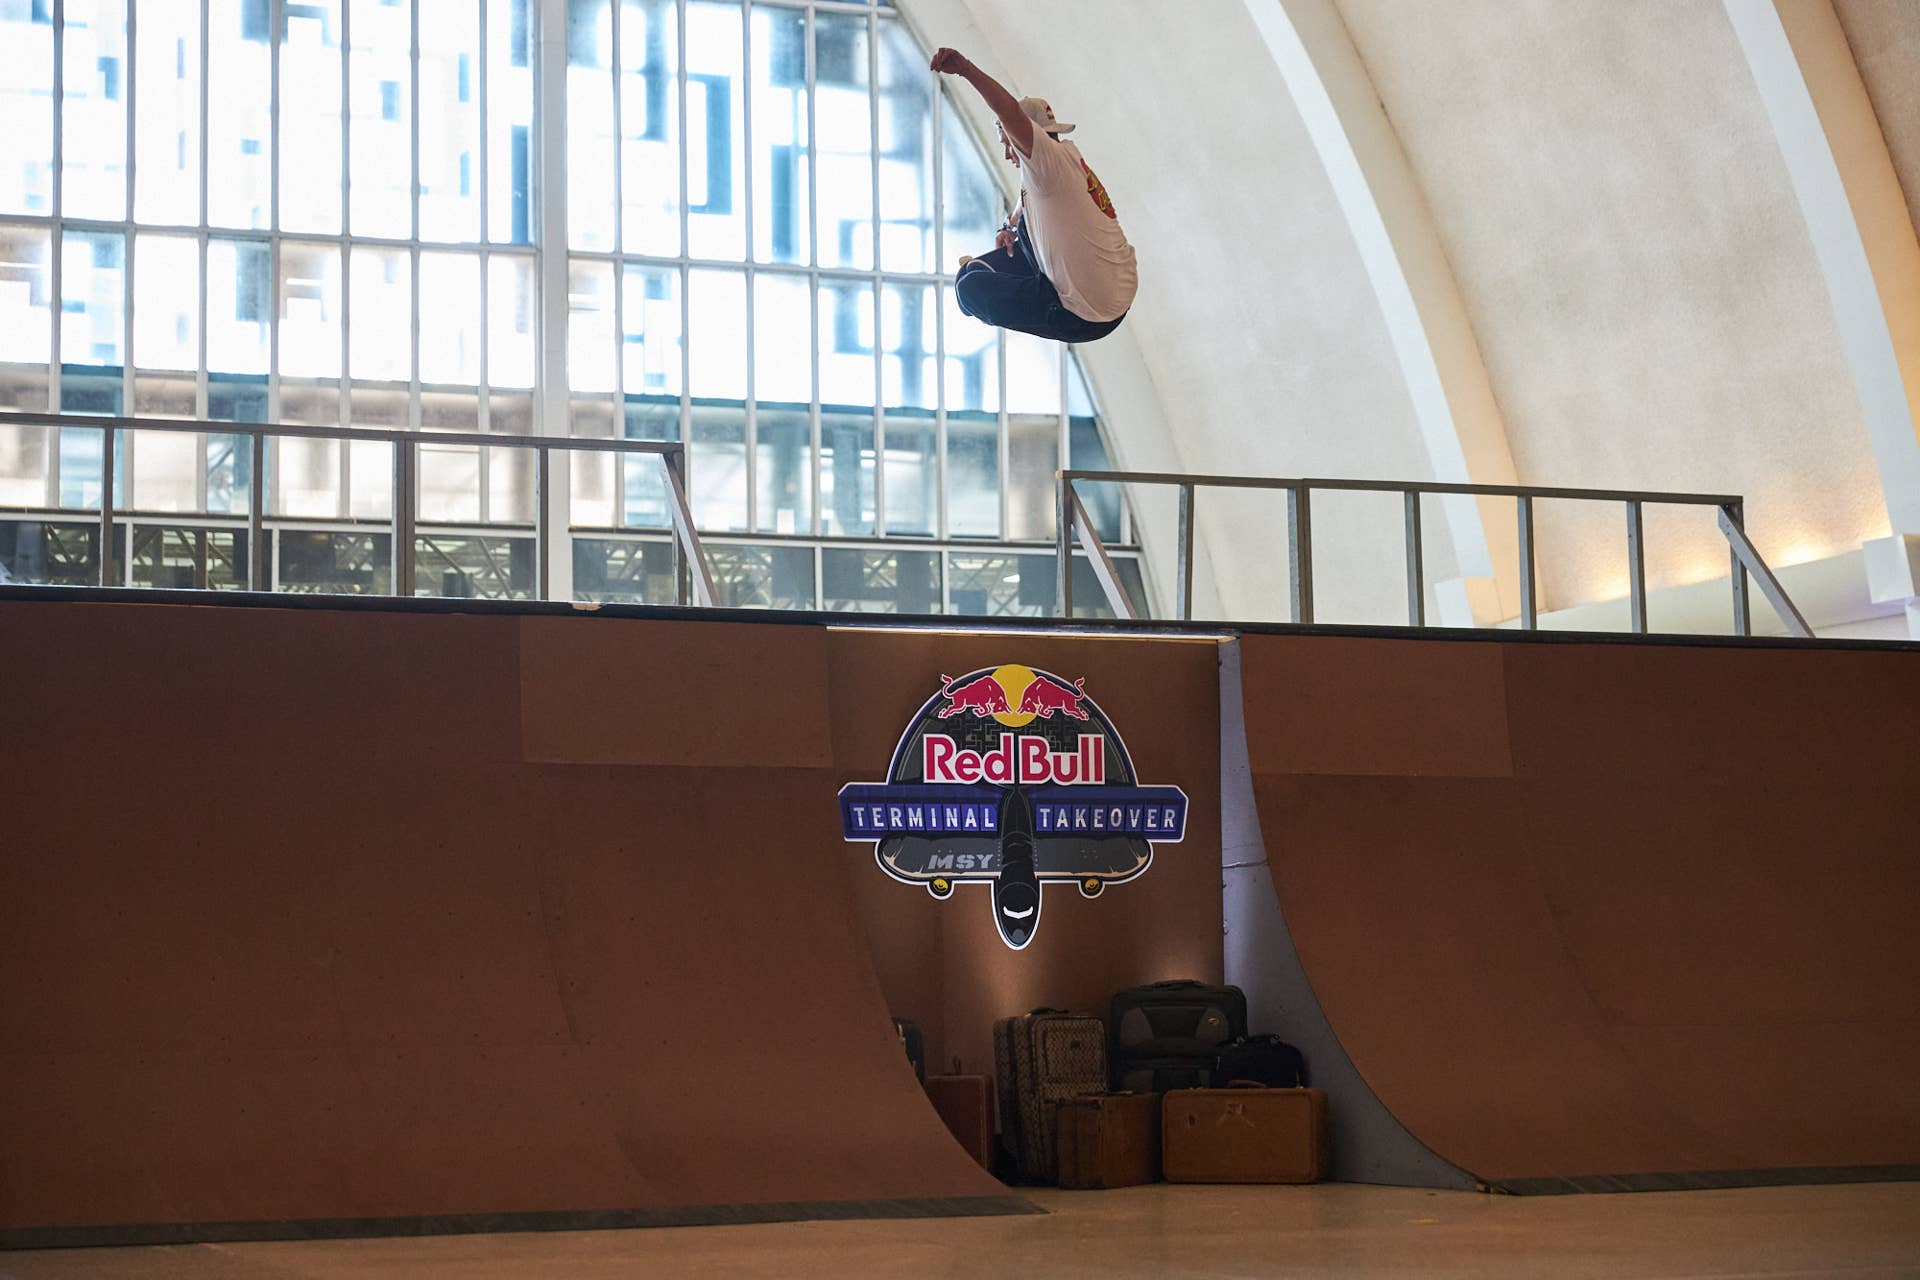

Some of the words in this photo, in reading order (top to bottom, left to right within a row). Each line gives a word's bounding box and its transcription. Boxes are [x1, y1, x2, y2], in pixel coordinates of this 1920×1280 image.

[924, 733, 1014, 783] Red
[1019, 735, 1105, 785] Bull
[853, 807, 995, 828] TERMINAL
[1039, 807, 1176, 828] TAKEOVER
[928, 854, 994, 870] MSY
